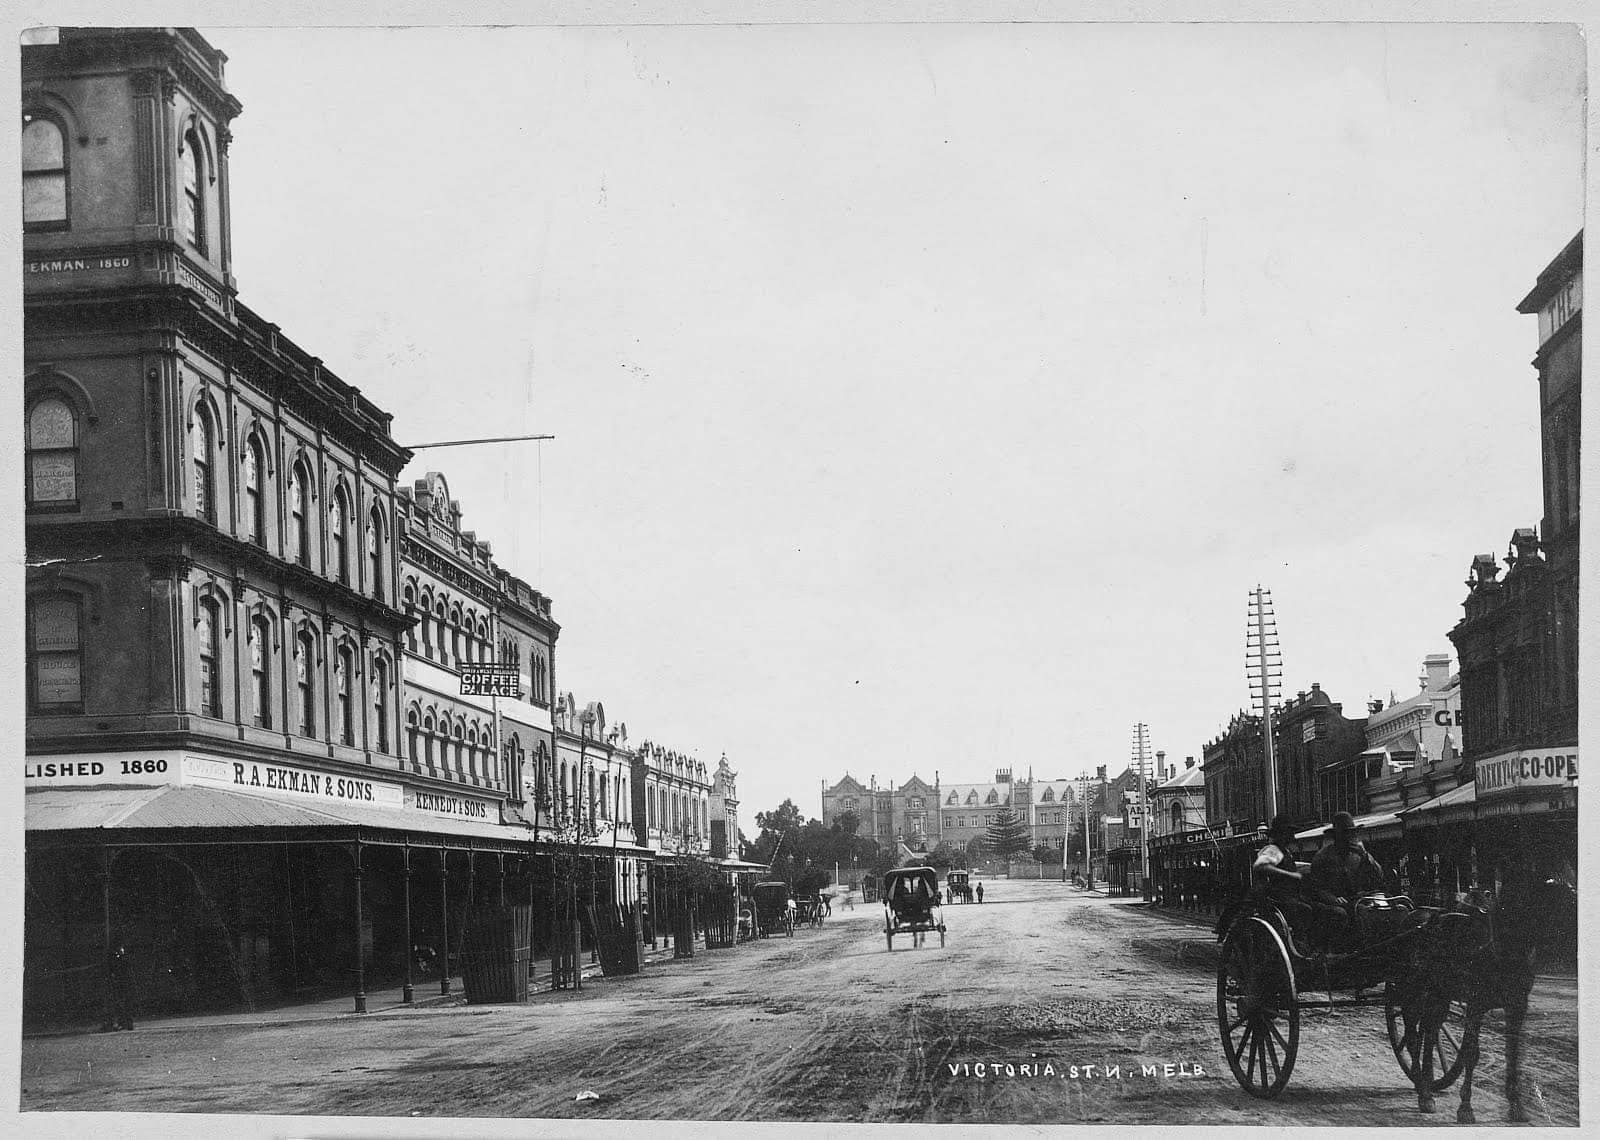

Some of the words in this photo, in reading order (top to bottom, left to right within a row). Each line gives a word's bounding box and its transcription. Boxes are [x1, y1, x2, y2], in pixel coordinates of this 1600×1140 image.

[100, 257, 130, 269] 1860
[462, 673, 518, 686] COFFEE
[461, 684, 518, 697] PALACE
[120, 759, 168, 775] 1860
[325, 776, 334, 796] &
[415, 791, 457, 814] KENNEDY
